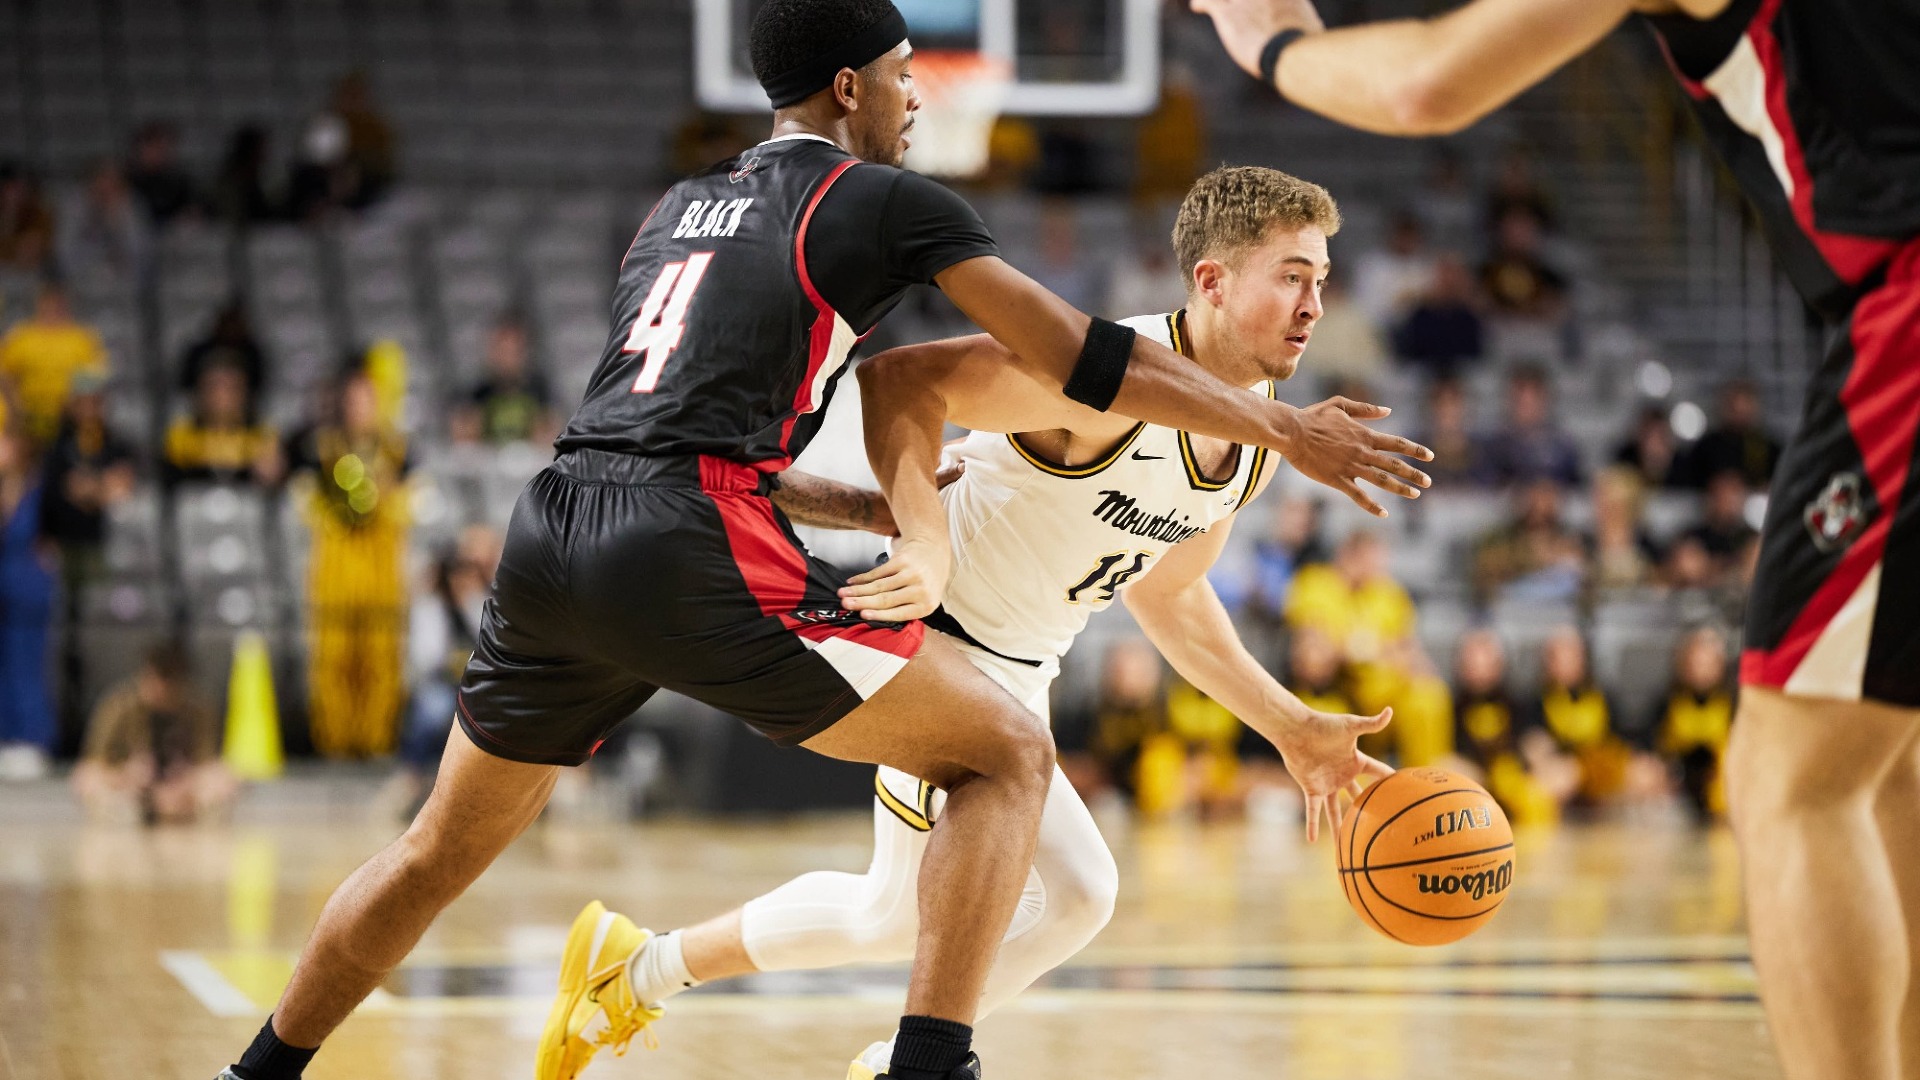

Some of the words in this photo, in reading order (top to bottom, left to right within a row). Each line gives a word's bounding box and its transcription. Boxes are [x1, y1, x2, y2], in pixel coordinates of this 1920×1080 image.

[671, 198, 754, 239] BLACK
[622, 251, 716, 394] 4
[1413, 829, 1435, 846] NXT
[1417, 859, 1513, 901] Wilson
